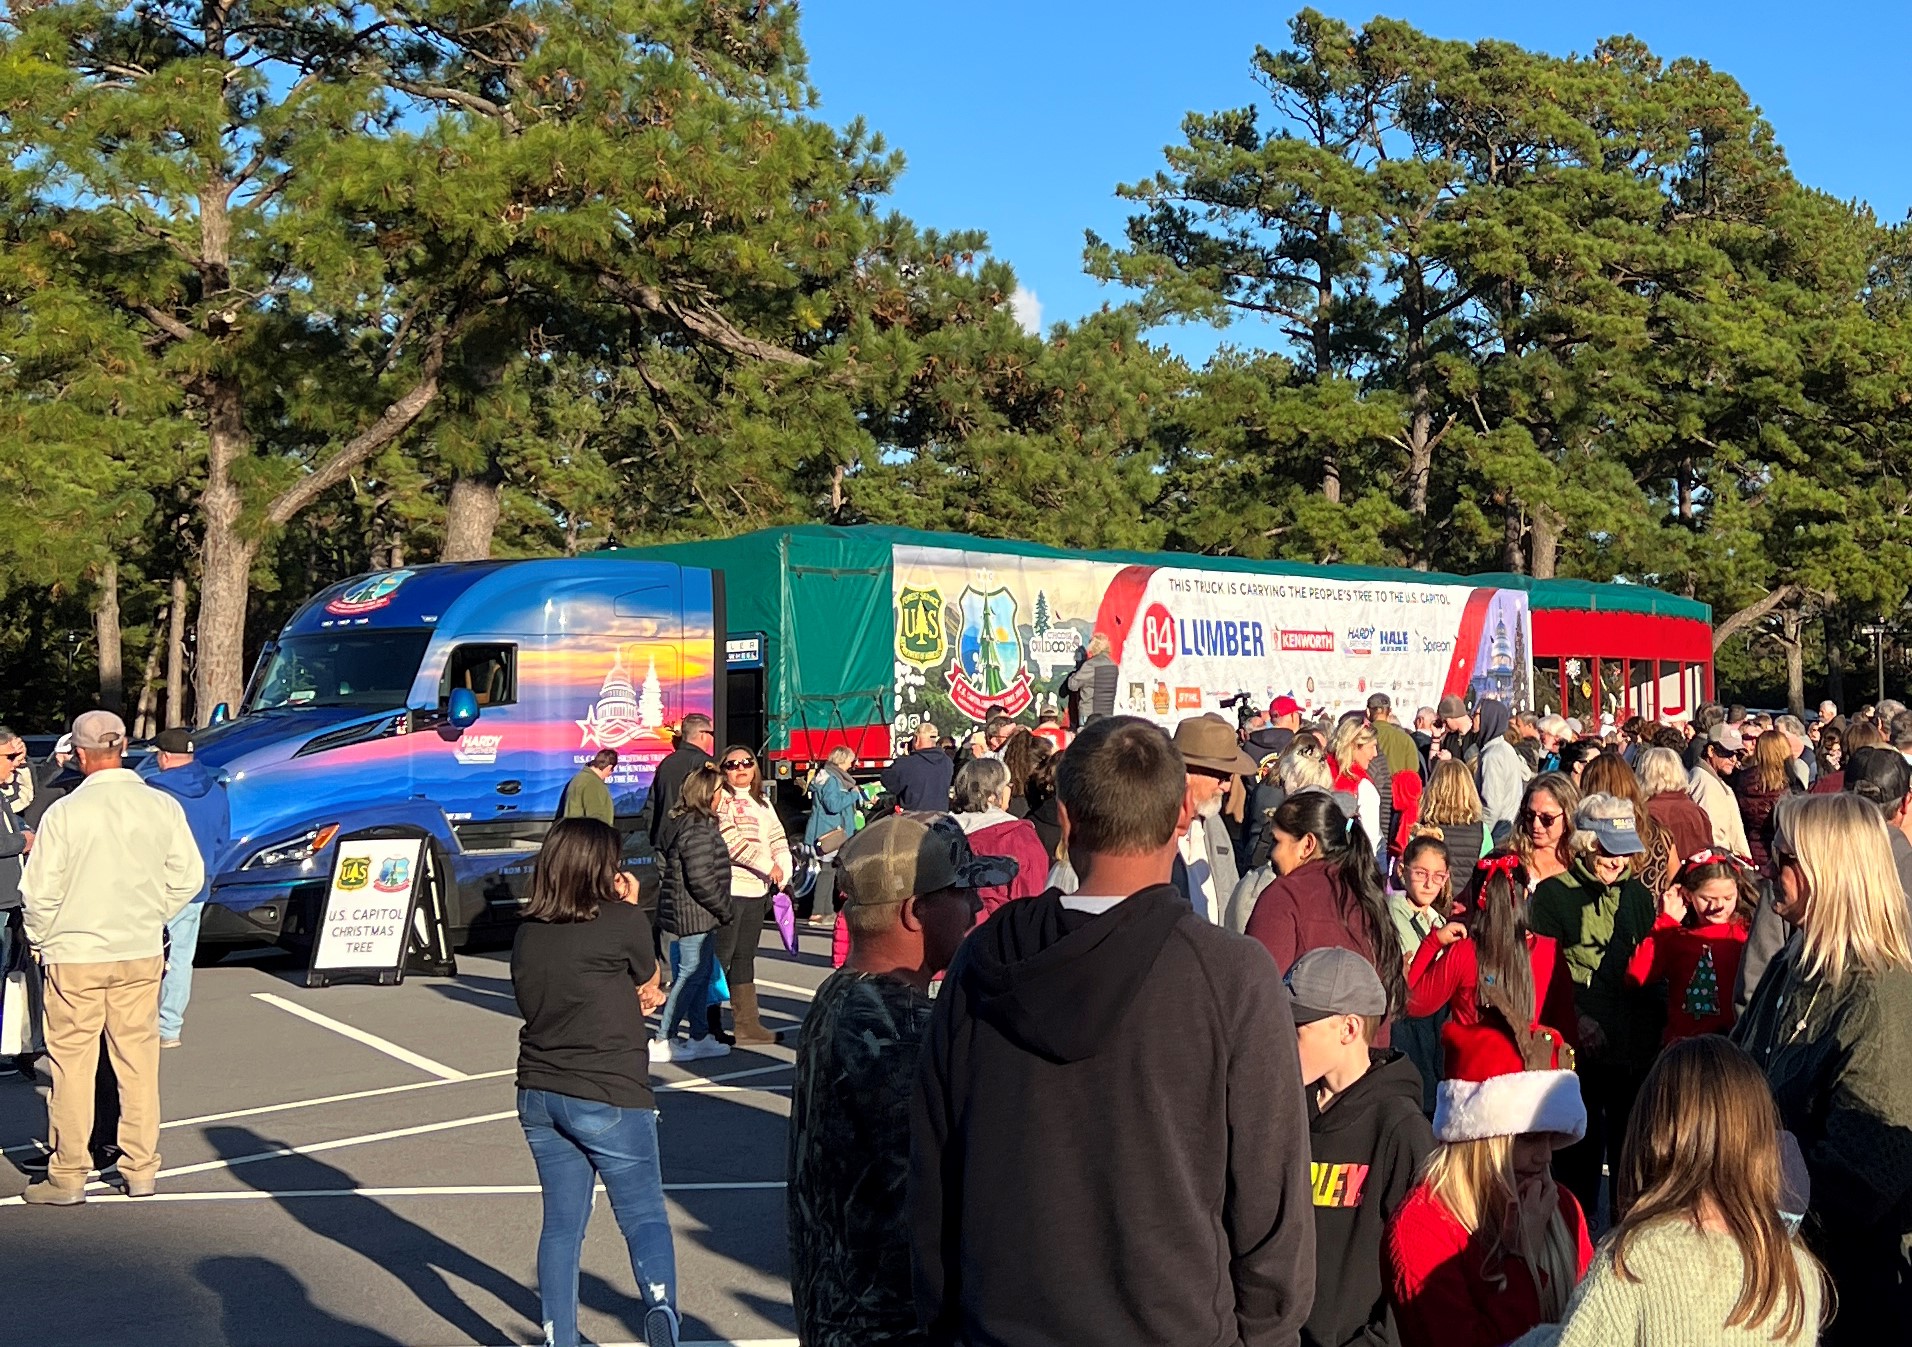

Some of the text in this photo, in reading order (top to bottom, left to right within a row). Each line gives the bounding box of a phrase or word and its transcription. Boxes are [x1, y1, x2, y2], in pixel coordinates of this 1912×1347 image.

[1168, 578, 1192, 593] THIS
[1194, 579, 1225, 594] TRUCK
[1227, 582, 1237, 595] IS
[1240, 582, 1286, 598] CARRYING
[1288, 585, 1307, 599] THE
[1309, 586, 1352, 602] PEOPLE'S
[1353, 589, 1373, 602] TREE
[1375, 590, 1388, 603] TO
[1389, 590, 1404, 603] THE
[1145, 615, 1265, 657] 84 LUMBER
[1347, 624, 1376, 640] HARDY
[1380, 631, 1409, 645] HALE
[1281, 632, 1333, 650] KENWORTH
[461, 735, 503, 748] HARDY
[328, 908, 404, 921] U.S. CAPITOL
[331, 926, 394, 937] CHRISTMAS
[345, 941, 374, 953] TREE
